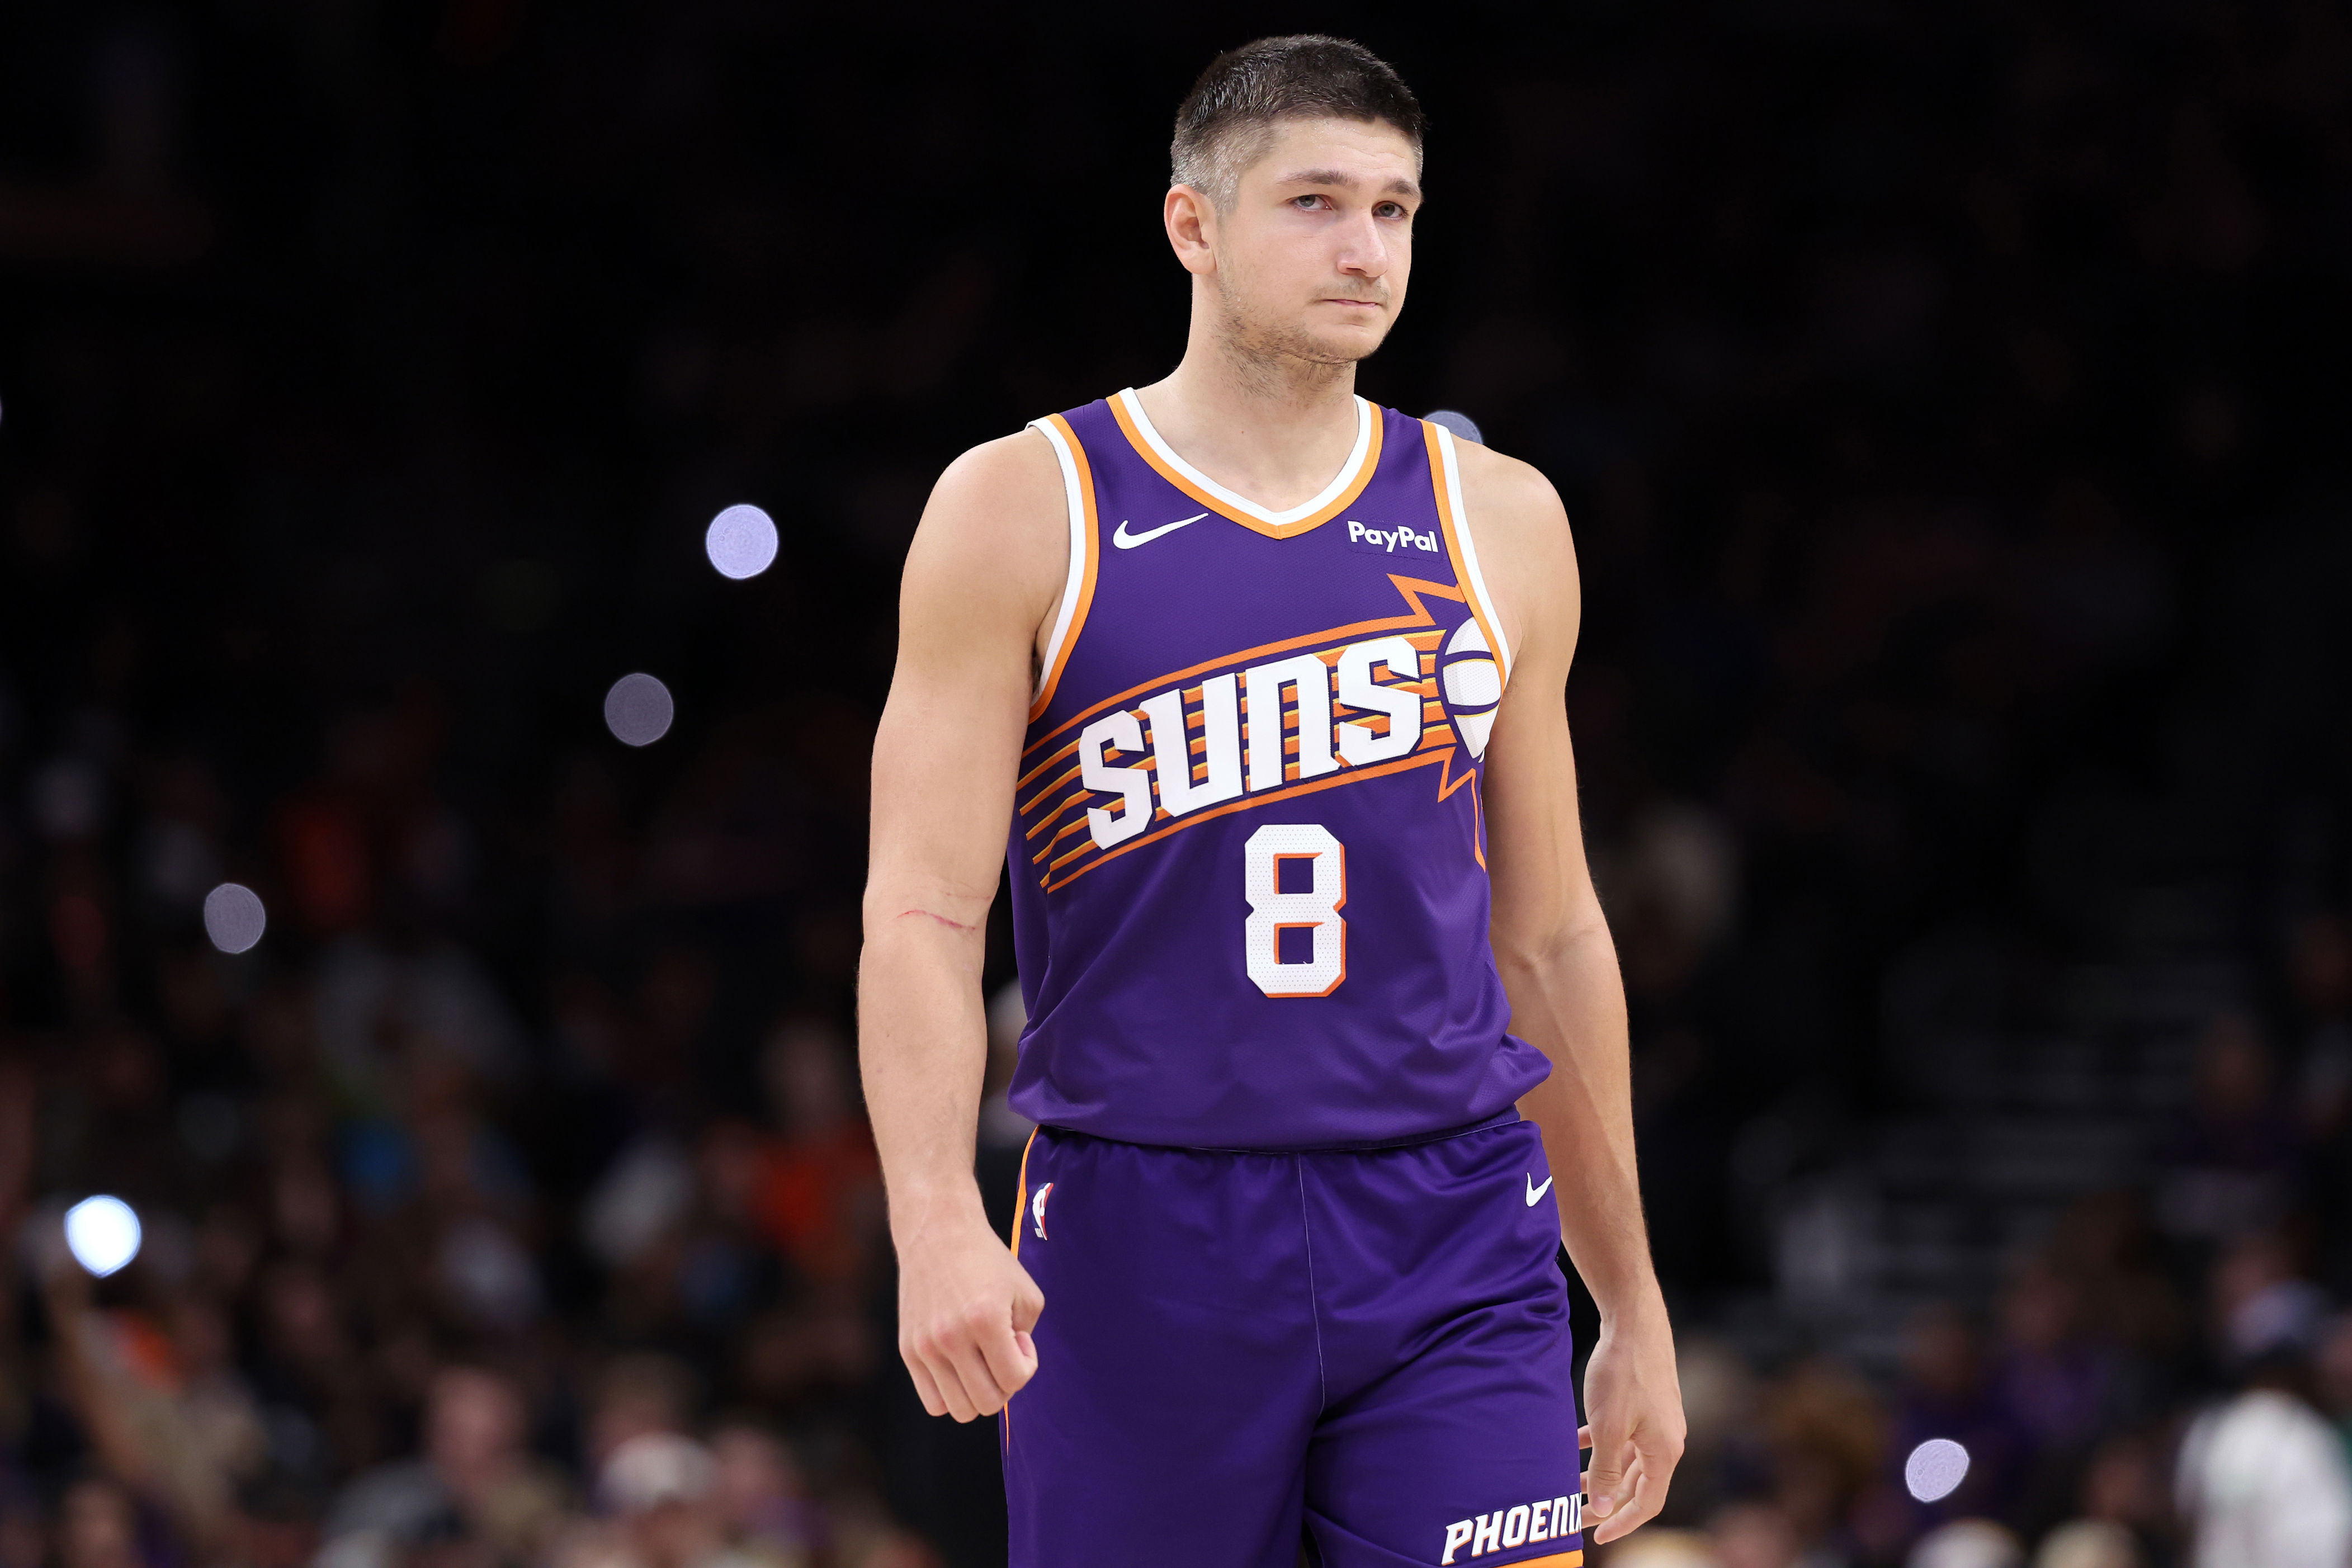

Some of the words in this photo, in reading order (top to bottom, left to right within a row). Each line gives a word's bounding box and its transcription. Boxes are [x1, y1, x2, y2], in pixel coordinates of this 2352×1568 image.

[1347, 521, 1438, 552] PayPal
[1078, 636, 1422, 849] SUNS
[1244, 824, 1347, 998] 8
